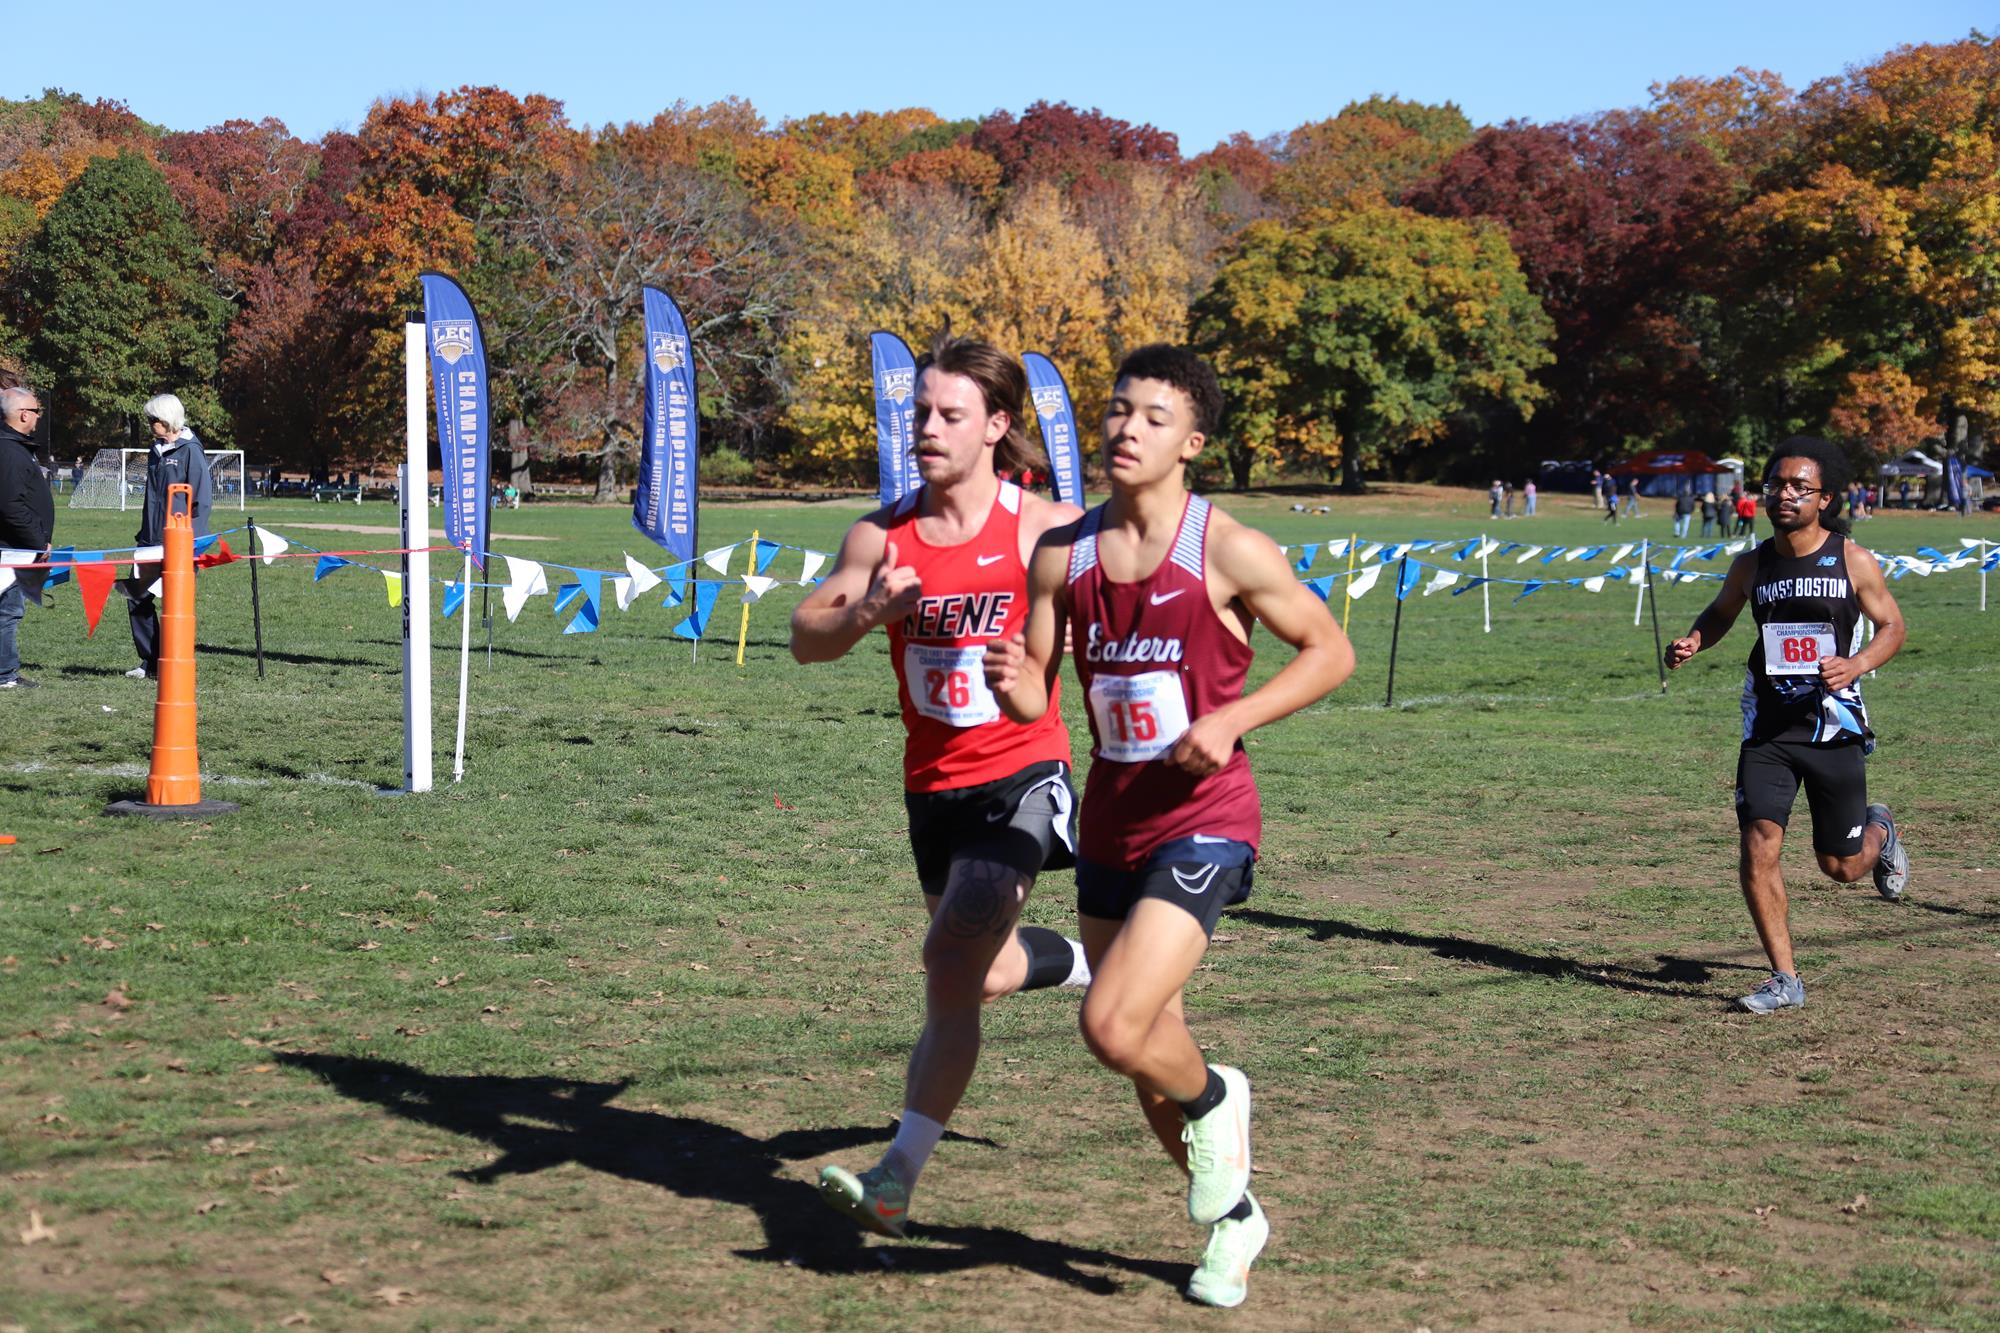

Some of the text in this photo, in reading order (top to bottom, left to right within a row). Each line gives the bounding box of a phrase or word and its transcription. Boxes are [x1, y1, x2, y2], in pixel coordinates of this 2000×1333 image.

[433, 326, 471, 344] LEC
[884, 373, 913, 388] LEC
[1033, 390, 1062, 404] LEC
[458, 371, 476, 537] CHAMPIONSHIP
[669, 381, 687, 535] CHAMPIONSHIP
[402, 509, 410, 639] FINISH
[1756, 577, 1847, 605] UMASS BOSTON
[1783, 637, 1817, 662] 68
[927, 669, 970, 708] 26
[1110, 701, 1157, 743] 15
